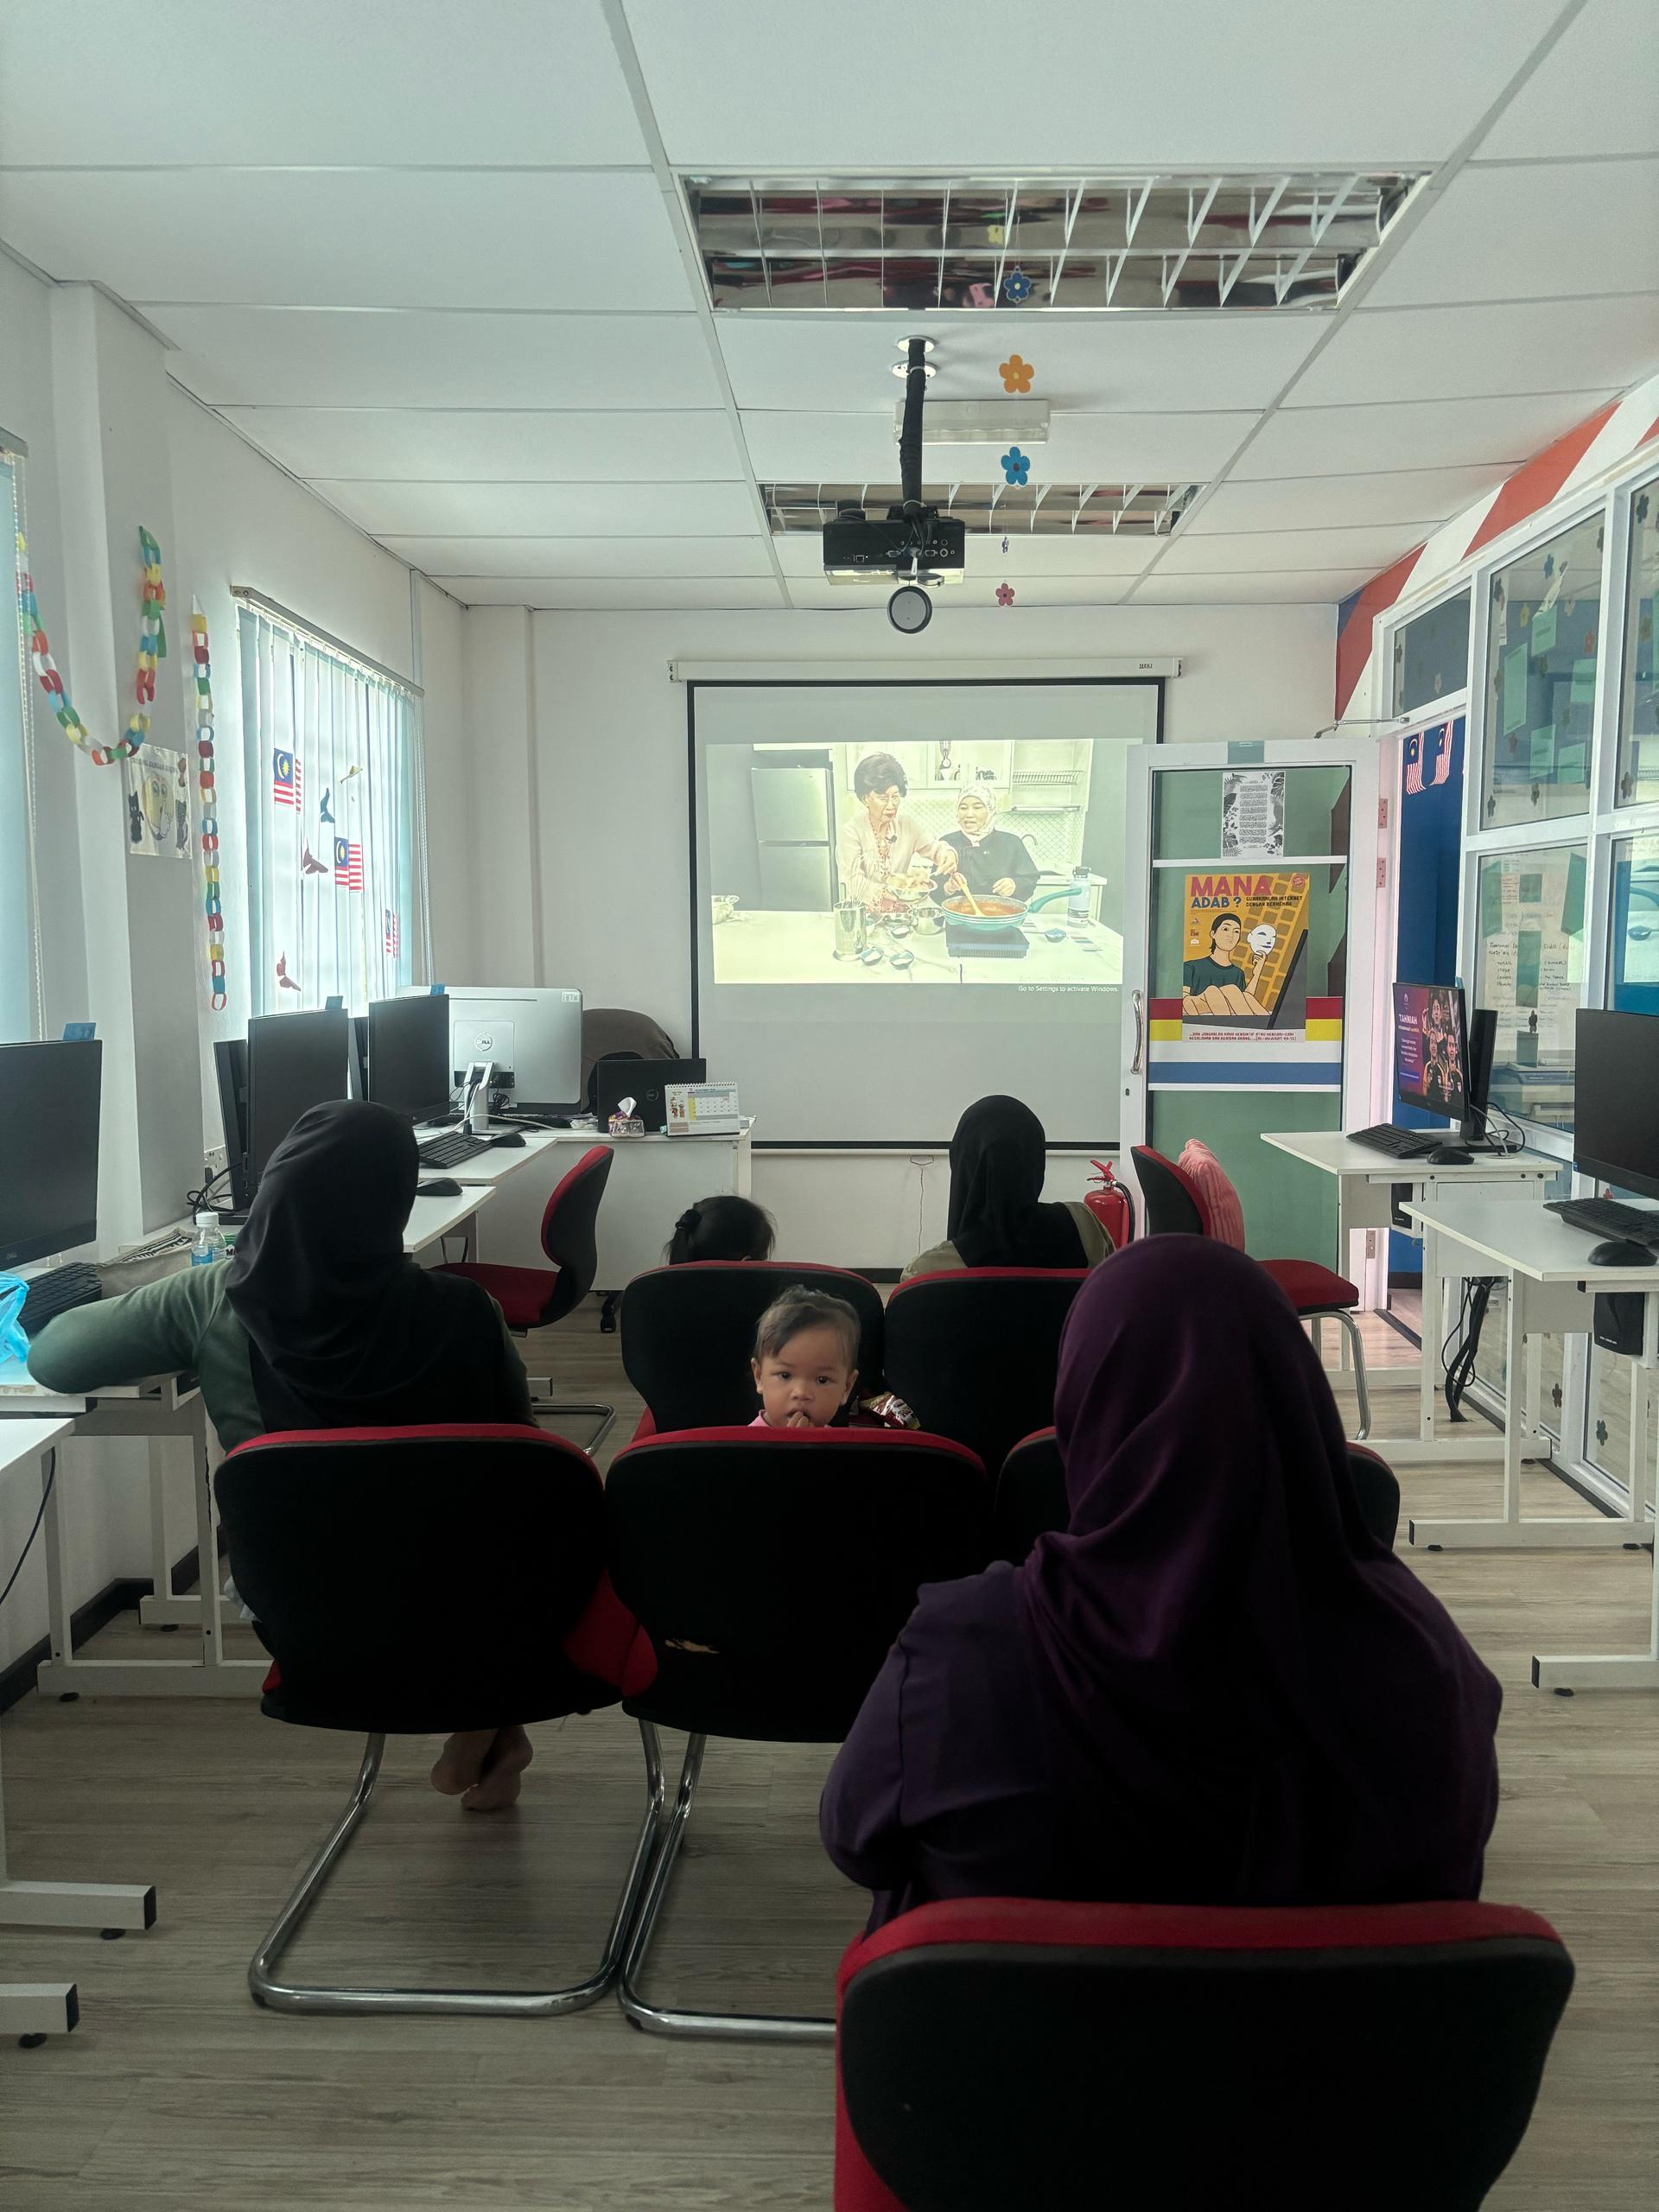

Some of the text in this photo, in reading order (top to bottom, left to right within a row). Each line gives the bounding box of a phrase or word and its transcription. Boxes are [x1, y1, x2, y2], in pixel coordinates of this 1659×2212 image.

[1191, 875, 1272, 897] MANA
[1192, 896, 1242, 908] ADAB ?
